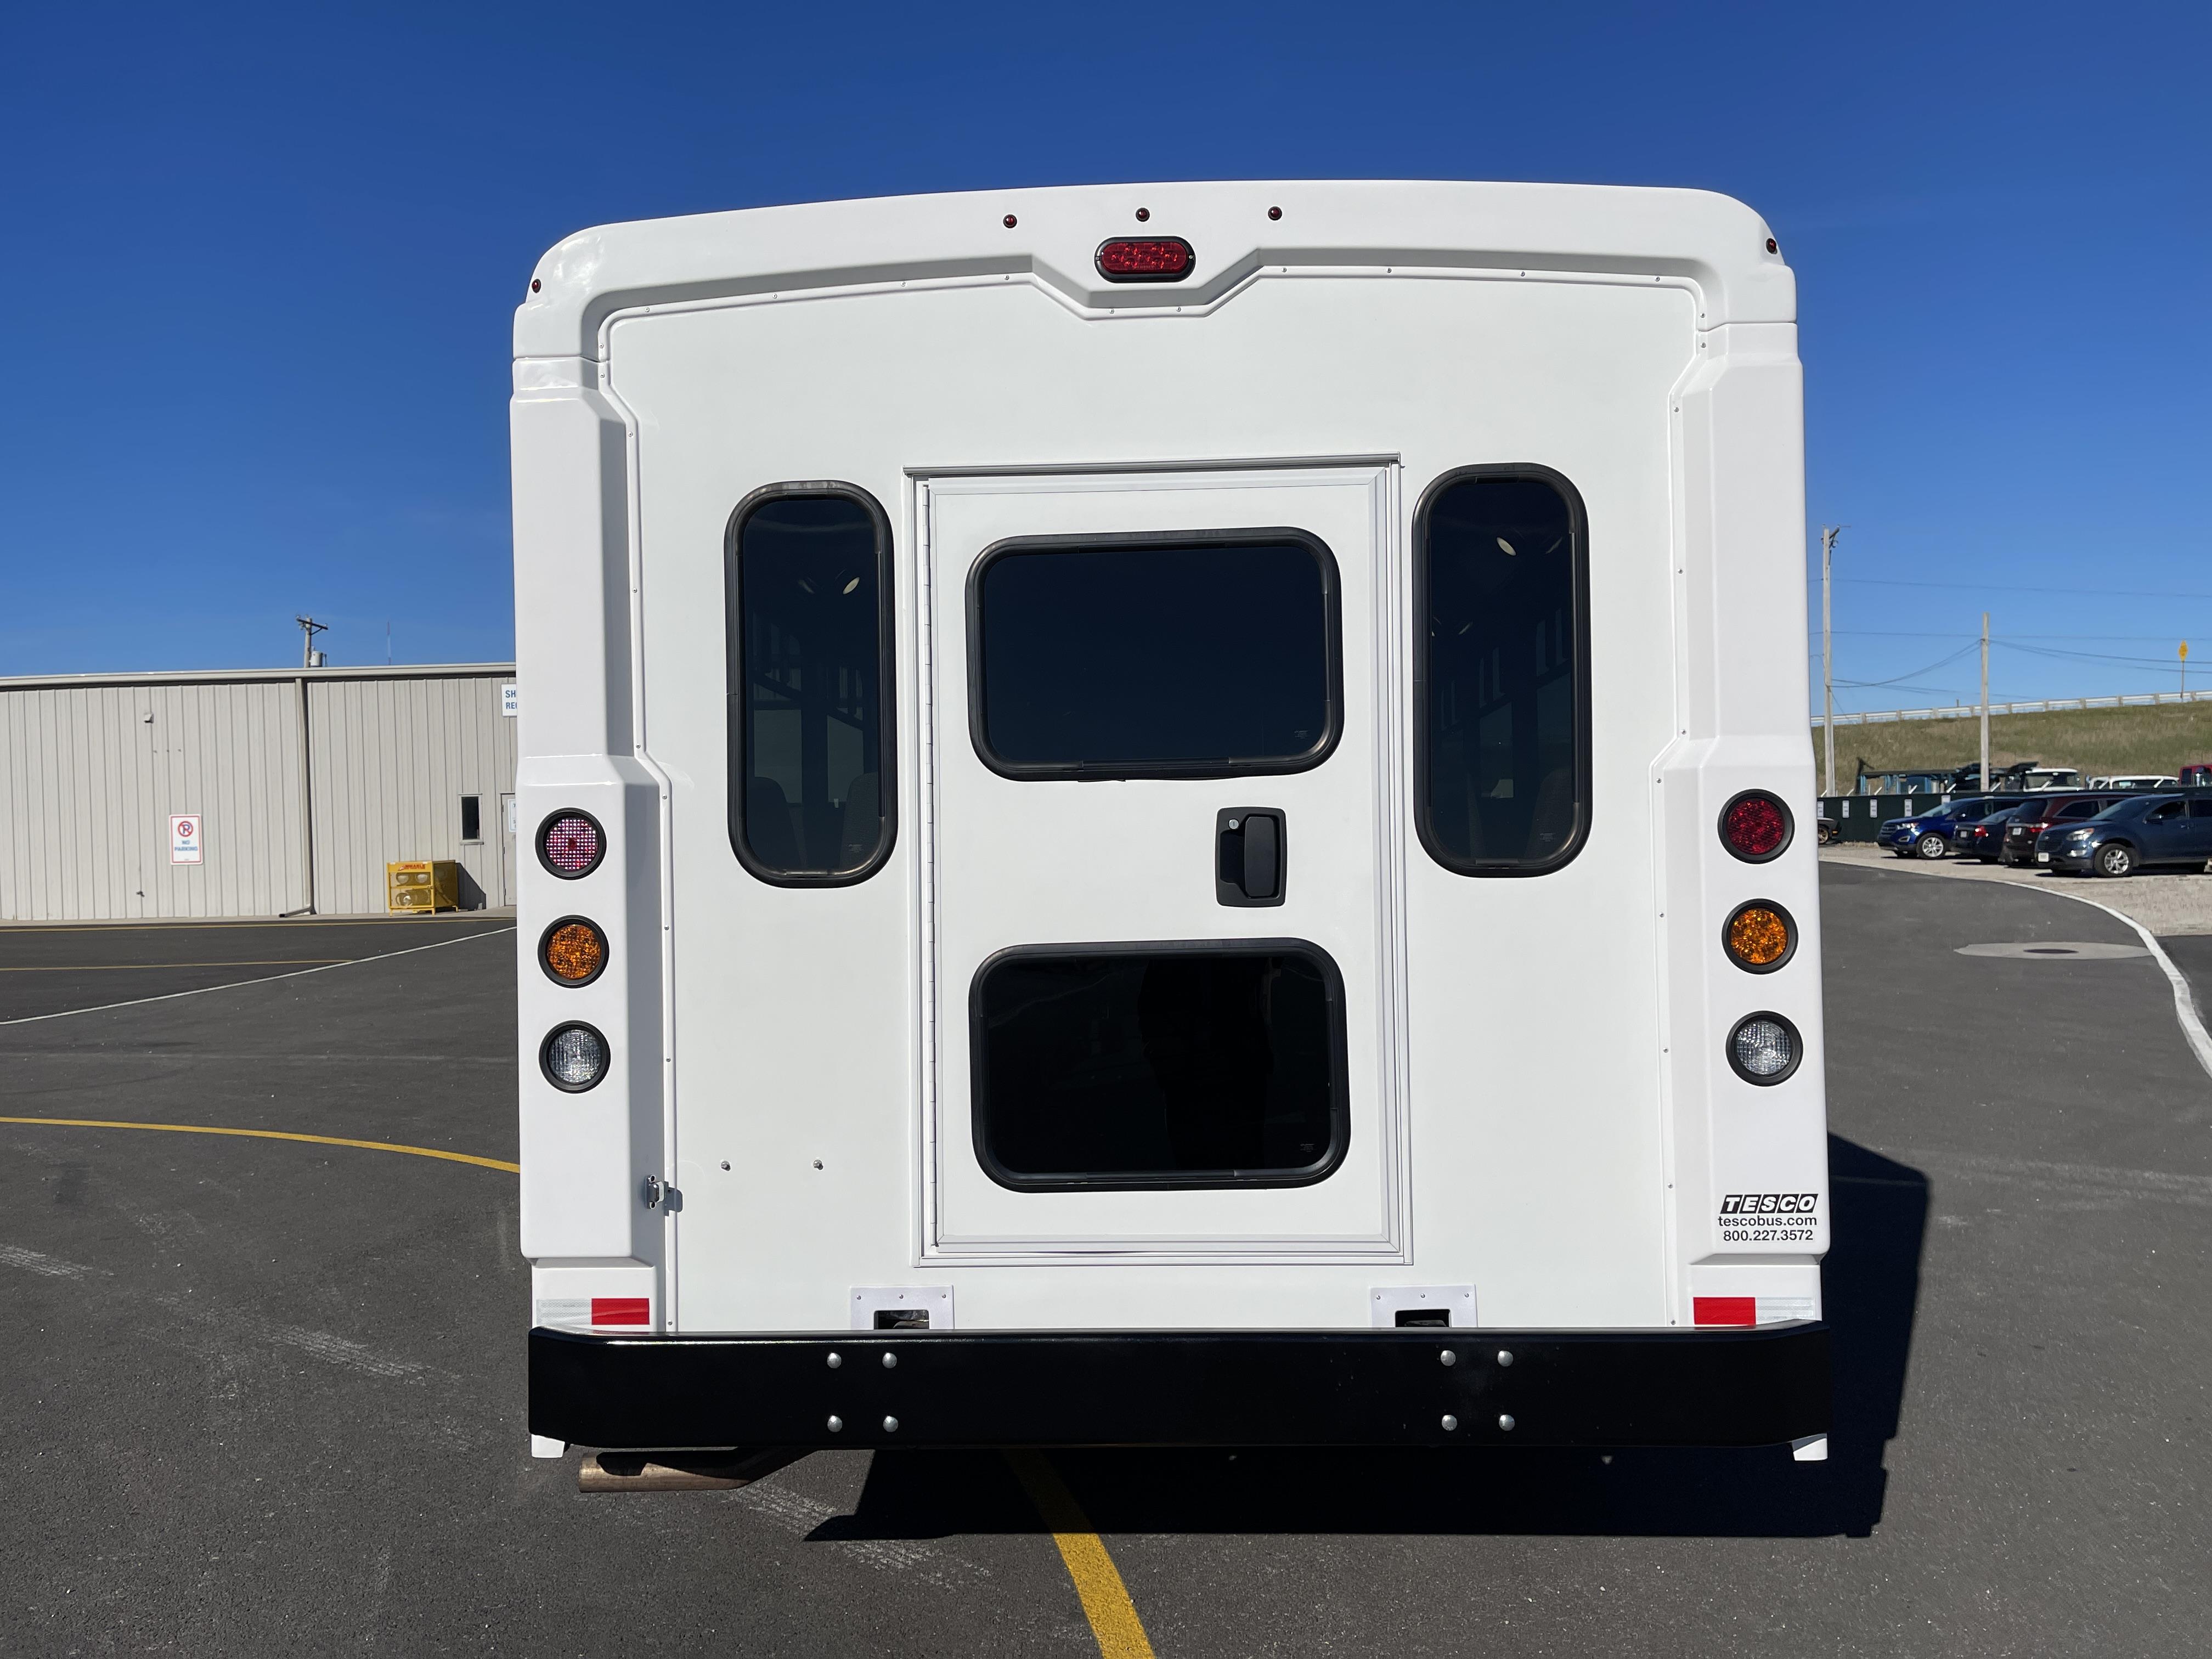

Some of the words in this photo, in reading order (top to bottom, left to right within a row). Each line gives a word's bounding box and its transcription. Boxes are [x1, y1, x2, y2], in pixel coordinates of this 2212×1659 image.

[1724, 1195, 1816, 1212] TESCO
[1718, 1215, 1817, 1227] tescobus.com
[1723, 1229, 1814, 1242] 800.227.3572
